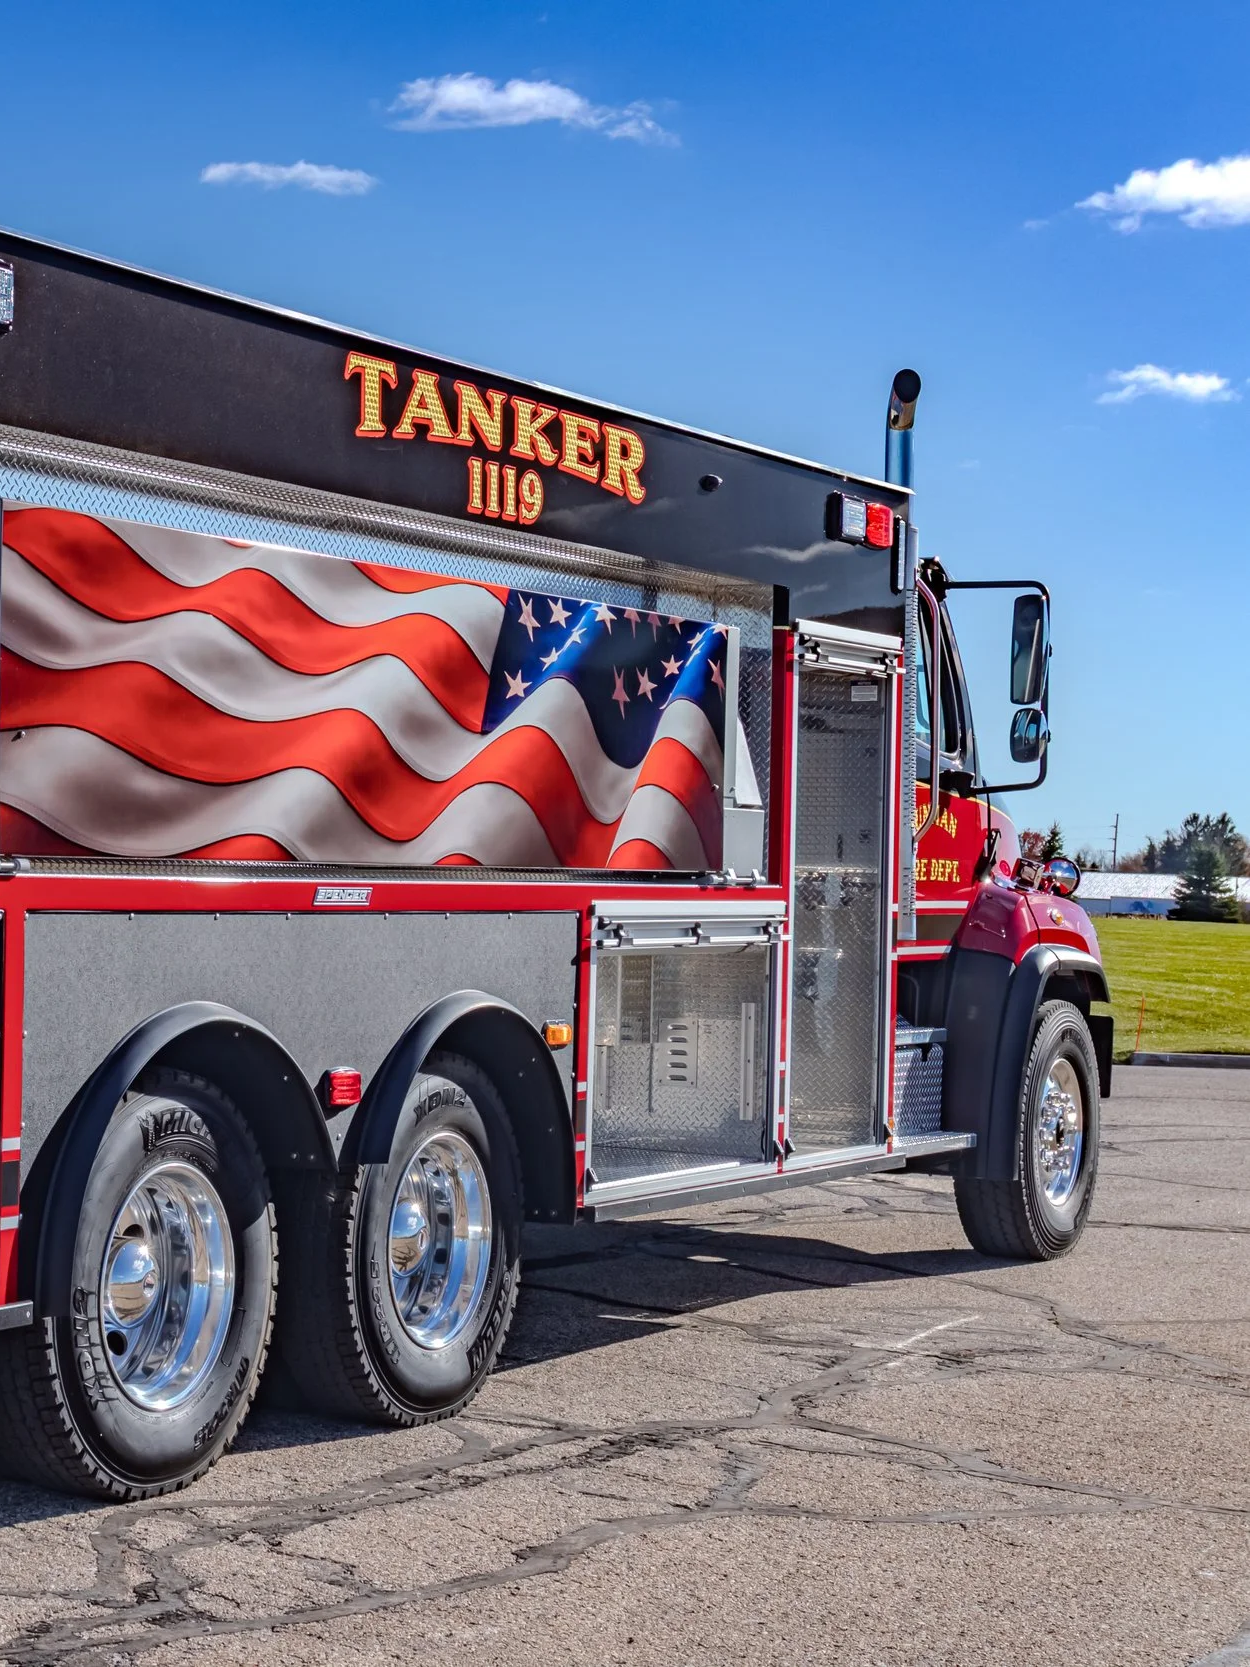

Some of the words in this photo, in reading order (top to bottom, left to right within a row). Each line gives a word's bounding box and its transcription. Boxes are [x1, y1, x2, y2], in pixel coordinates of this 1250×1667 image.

[344, 351, 646, 505] TANKER
[467, 456, 545, 525] 1119
[316, 889, 368, 901] SPENCER
[930, 859, 960, 882] DEPT.
[470, 1270, 513, 1378] CHELIN
